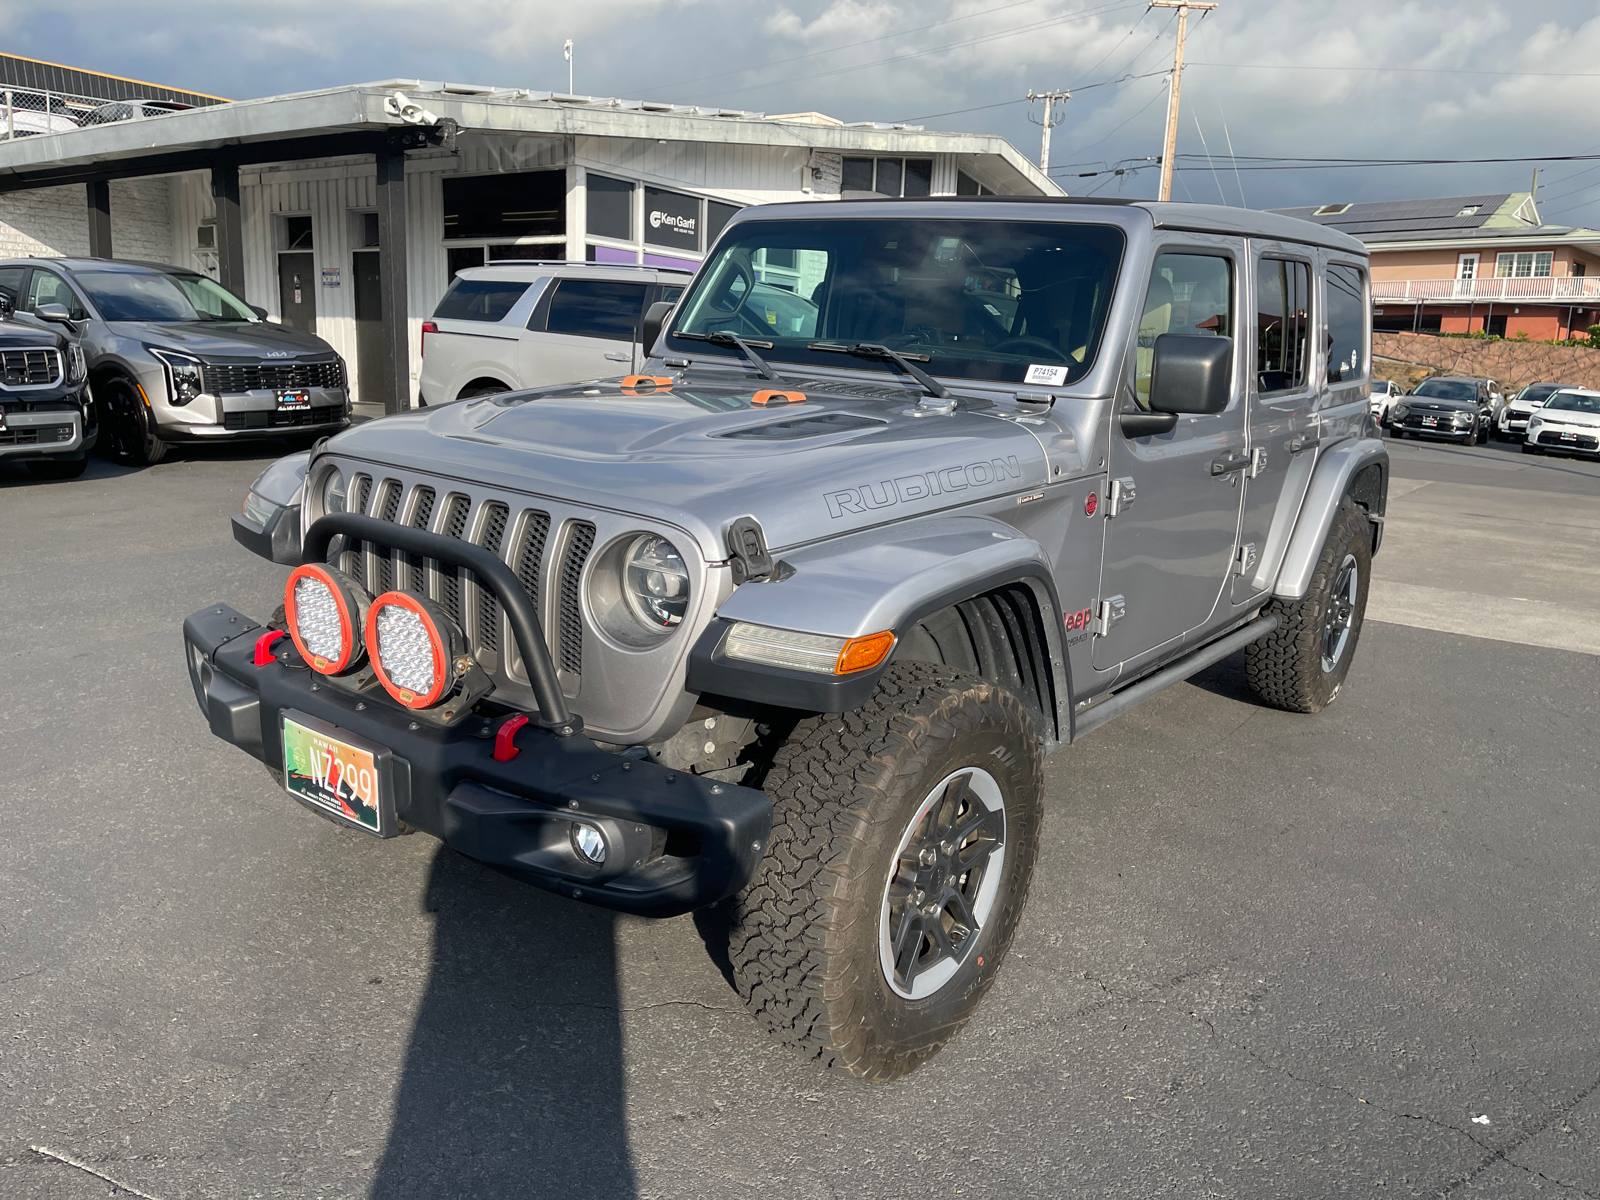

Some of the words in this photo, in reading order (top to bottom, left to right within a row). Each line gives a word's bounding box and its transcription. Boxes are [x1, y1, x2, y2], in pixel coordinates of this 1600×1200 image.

[661, 212, 676, 226] Ken
[676, 216, 695, 229] Garff
[1033, 367, 1059, 377] P74154
[823, 455, 1022, 519] RUBICON
[313, 738, 339, 754] HAWAII
[309, 746, 372, 807] NZ299
